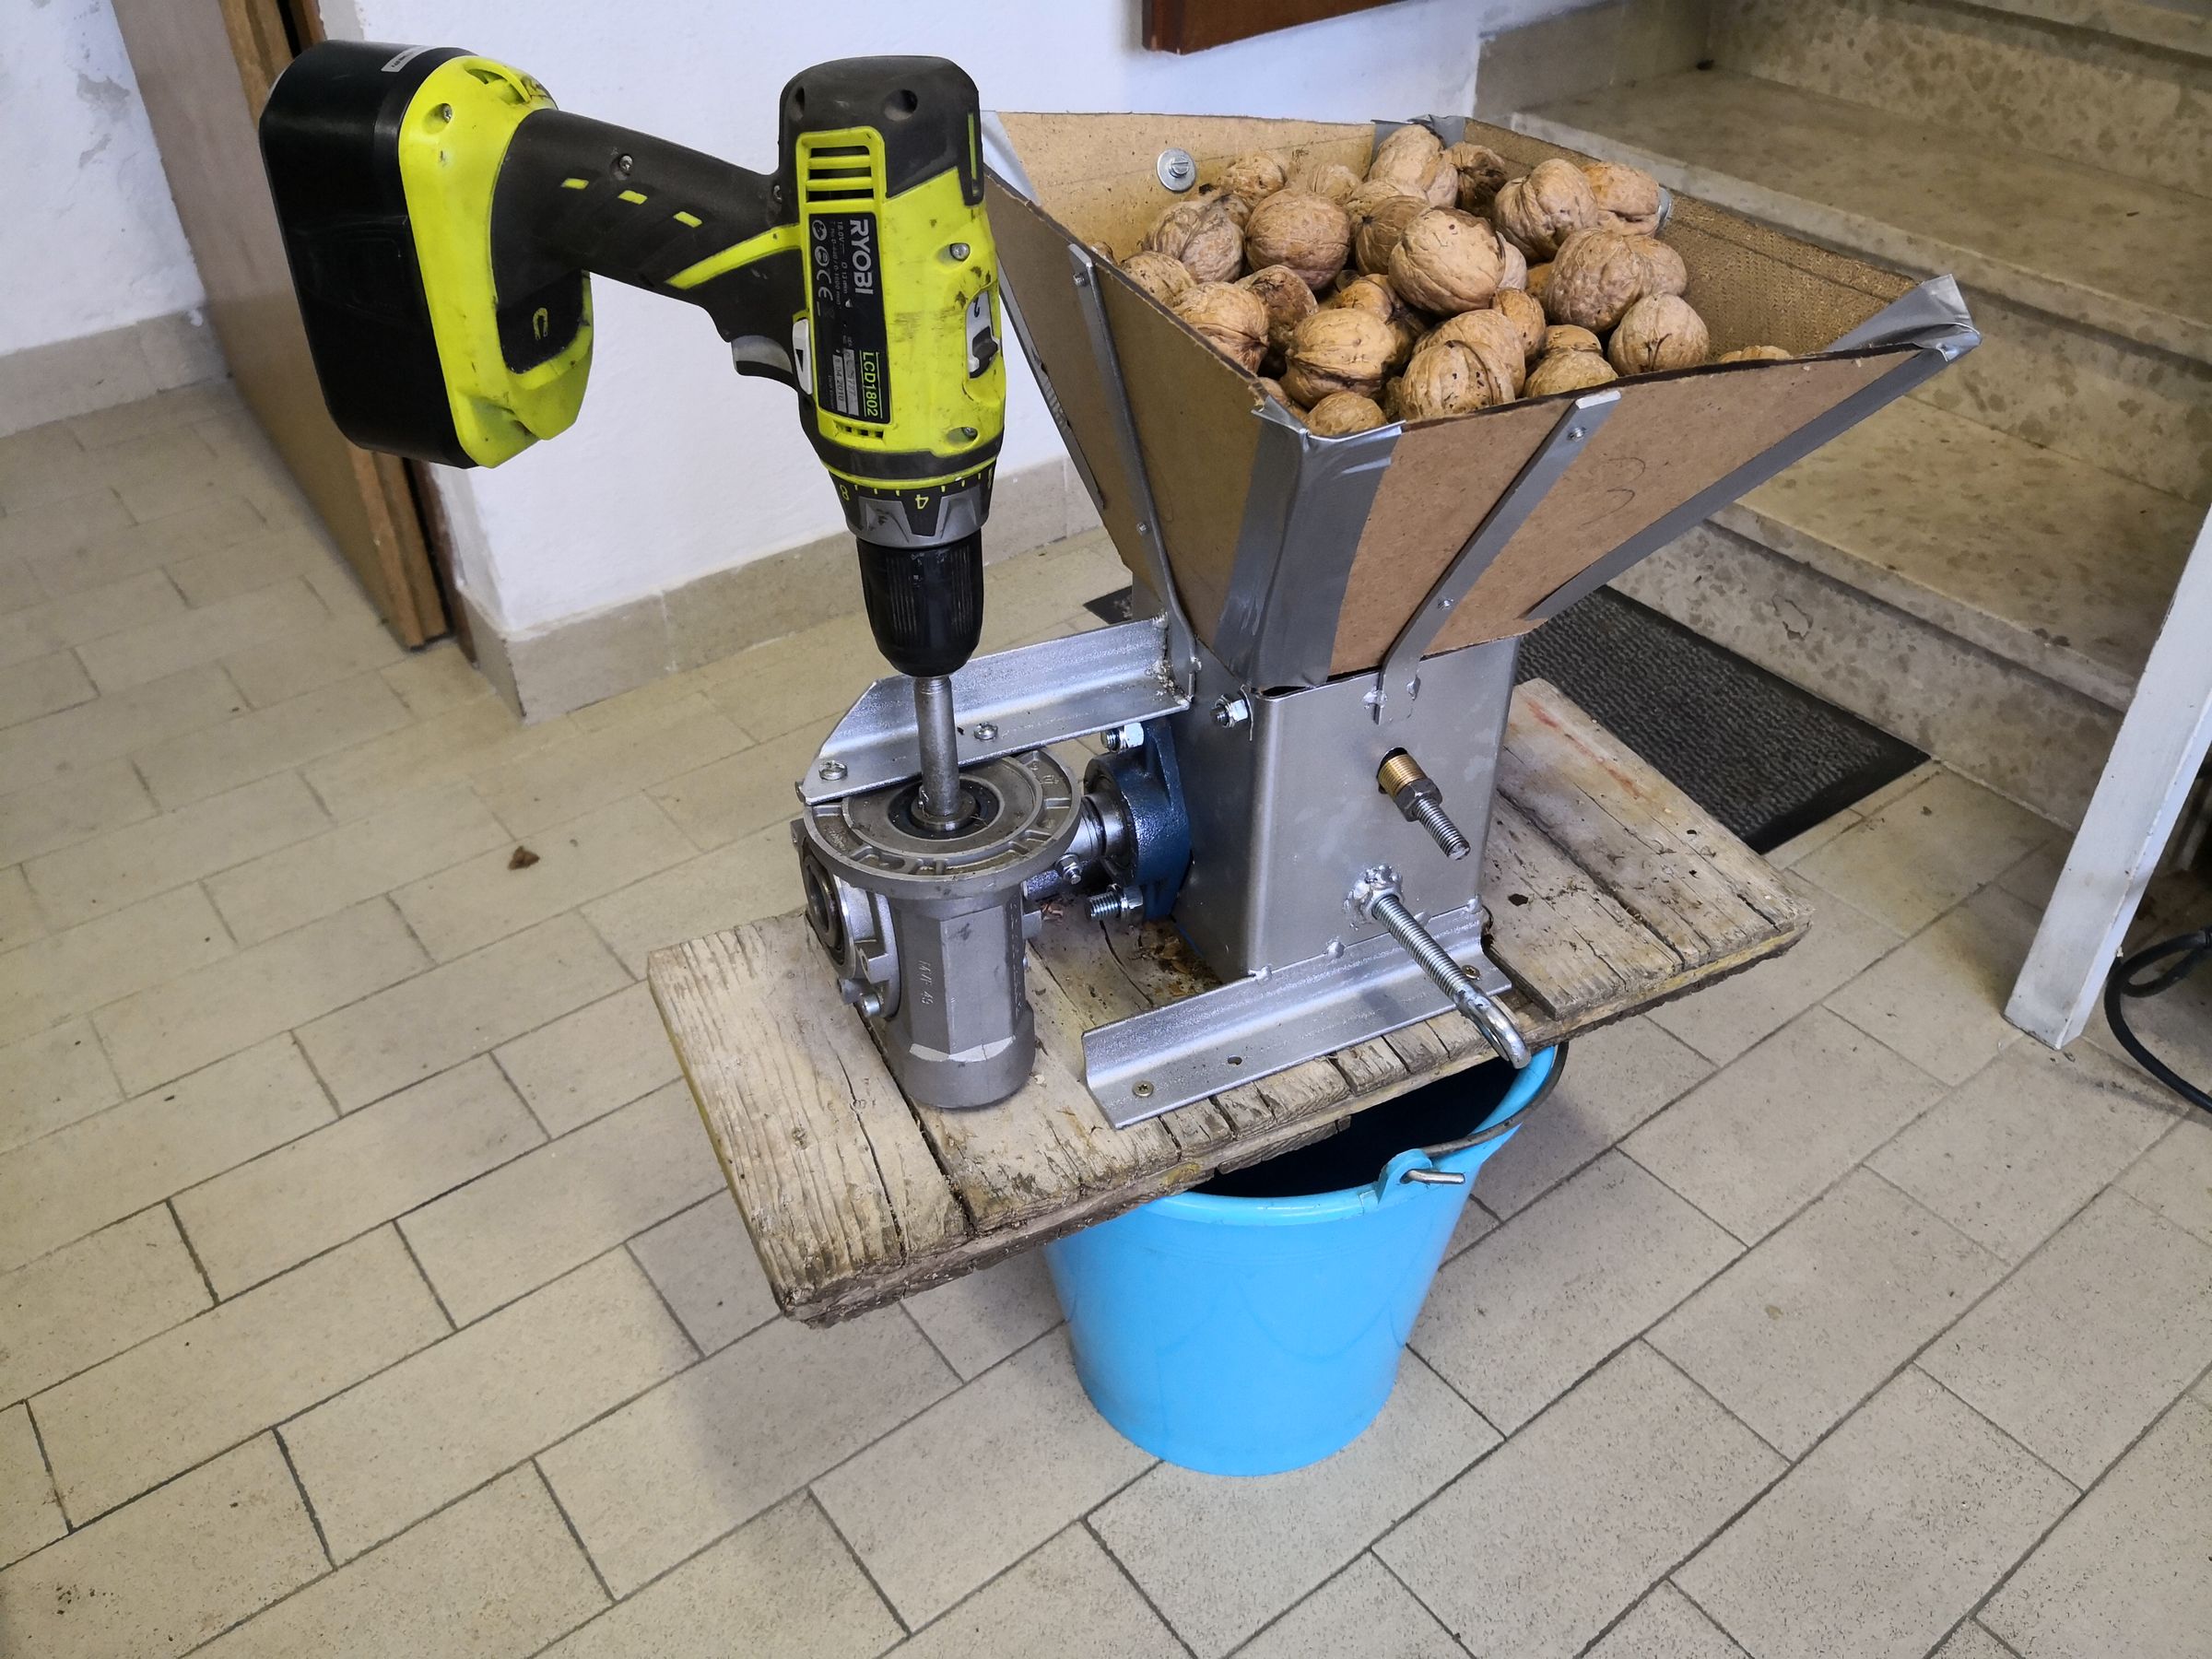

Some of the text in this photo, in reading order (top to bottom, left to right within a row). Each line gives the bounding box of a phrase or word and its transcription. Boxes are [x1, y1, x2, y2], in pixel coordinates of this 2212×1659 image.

[850, 219, 874, 295] RYOBI
[863, 351, 878, 417] LCD1802
[915, 494, 929, 510] 4
